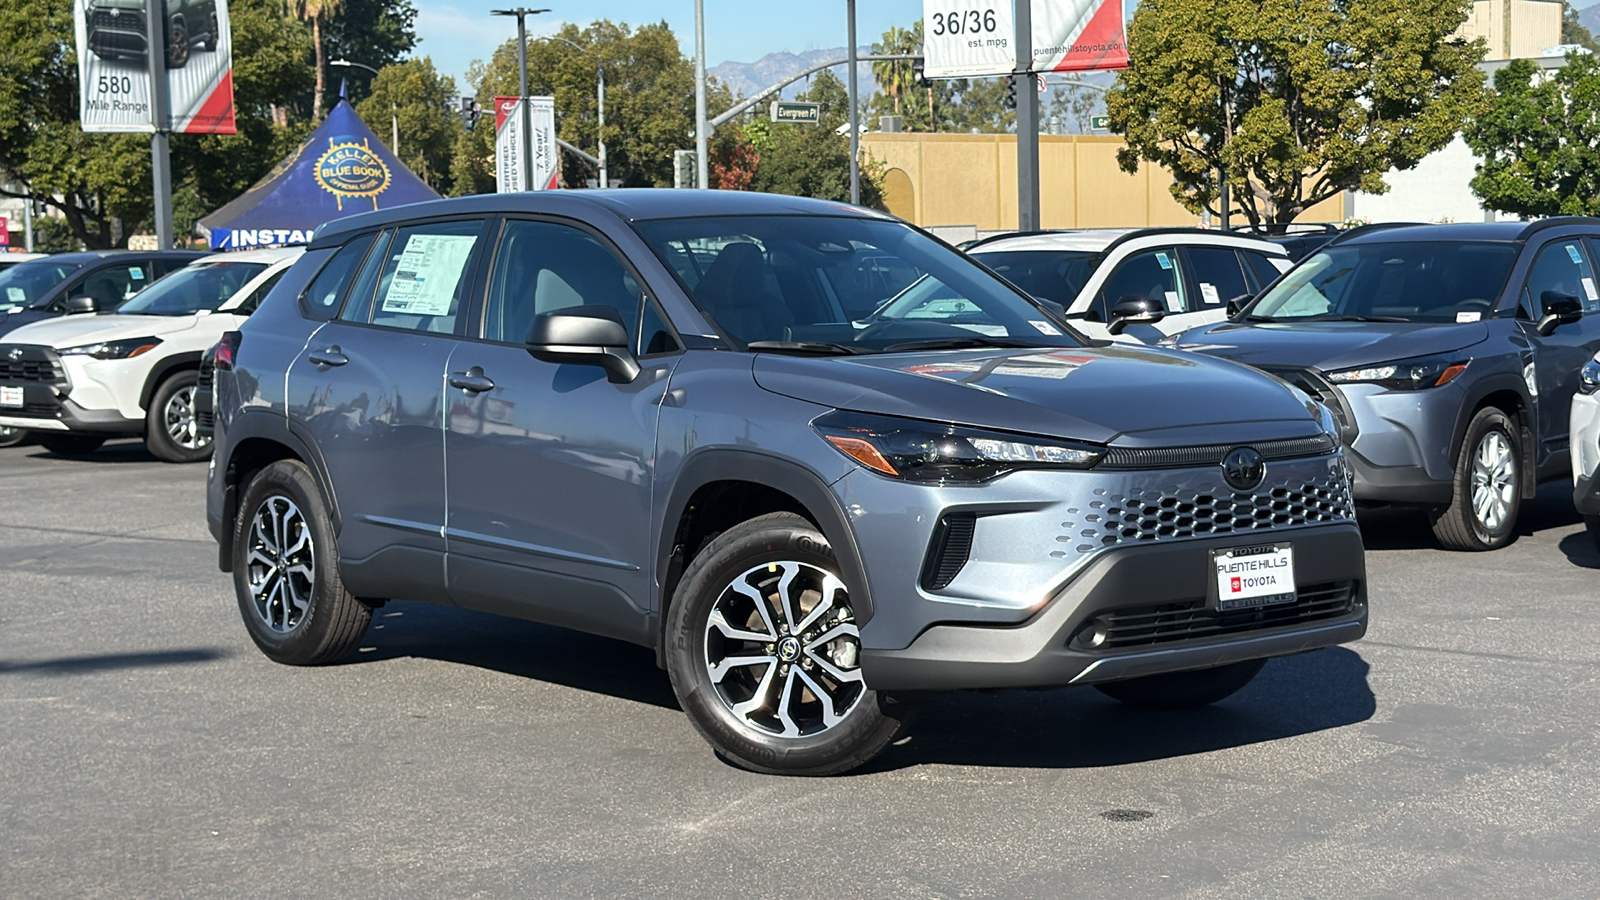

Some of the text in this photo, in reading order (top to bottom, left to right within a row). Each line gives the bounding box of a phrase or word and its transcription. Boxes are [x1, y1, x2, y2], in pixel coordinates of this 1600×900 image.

[933, 9, 996, 36] 36/36
[968, 38, 1007, 48] est. mpg
[99, 76, 131, 94] 580
[87, 100, 148, 114] Mile Range
[778, 107, 817, 120] Evergreen Pl
[327, 149, 378, 166] KELLEY
[322, 166, 384, 179] BLUE BOOK
[503, 146, 511, 193] CERTIFIED
[1233, 545, 1275, 556] TOYOTA
[1217, 557, 1288, 574] PUENTE HILLS
[1243, 575, 1277, 588] TOYOTA
